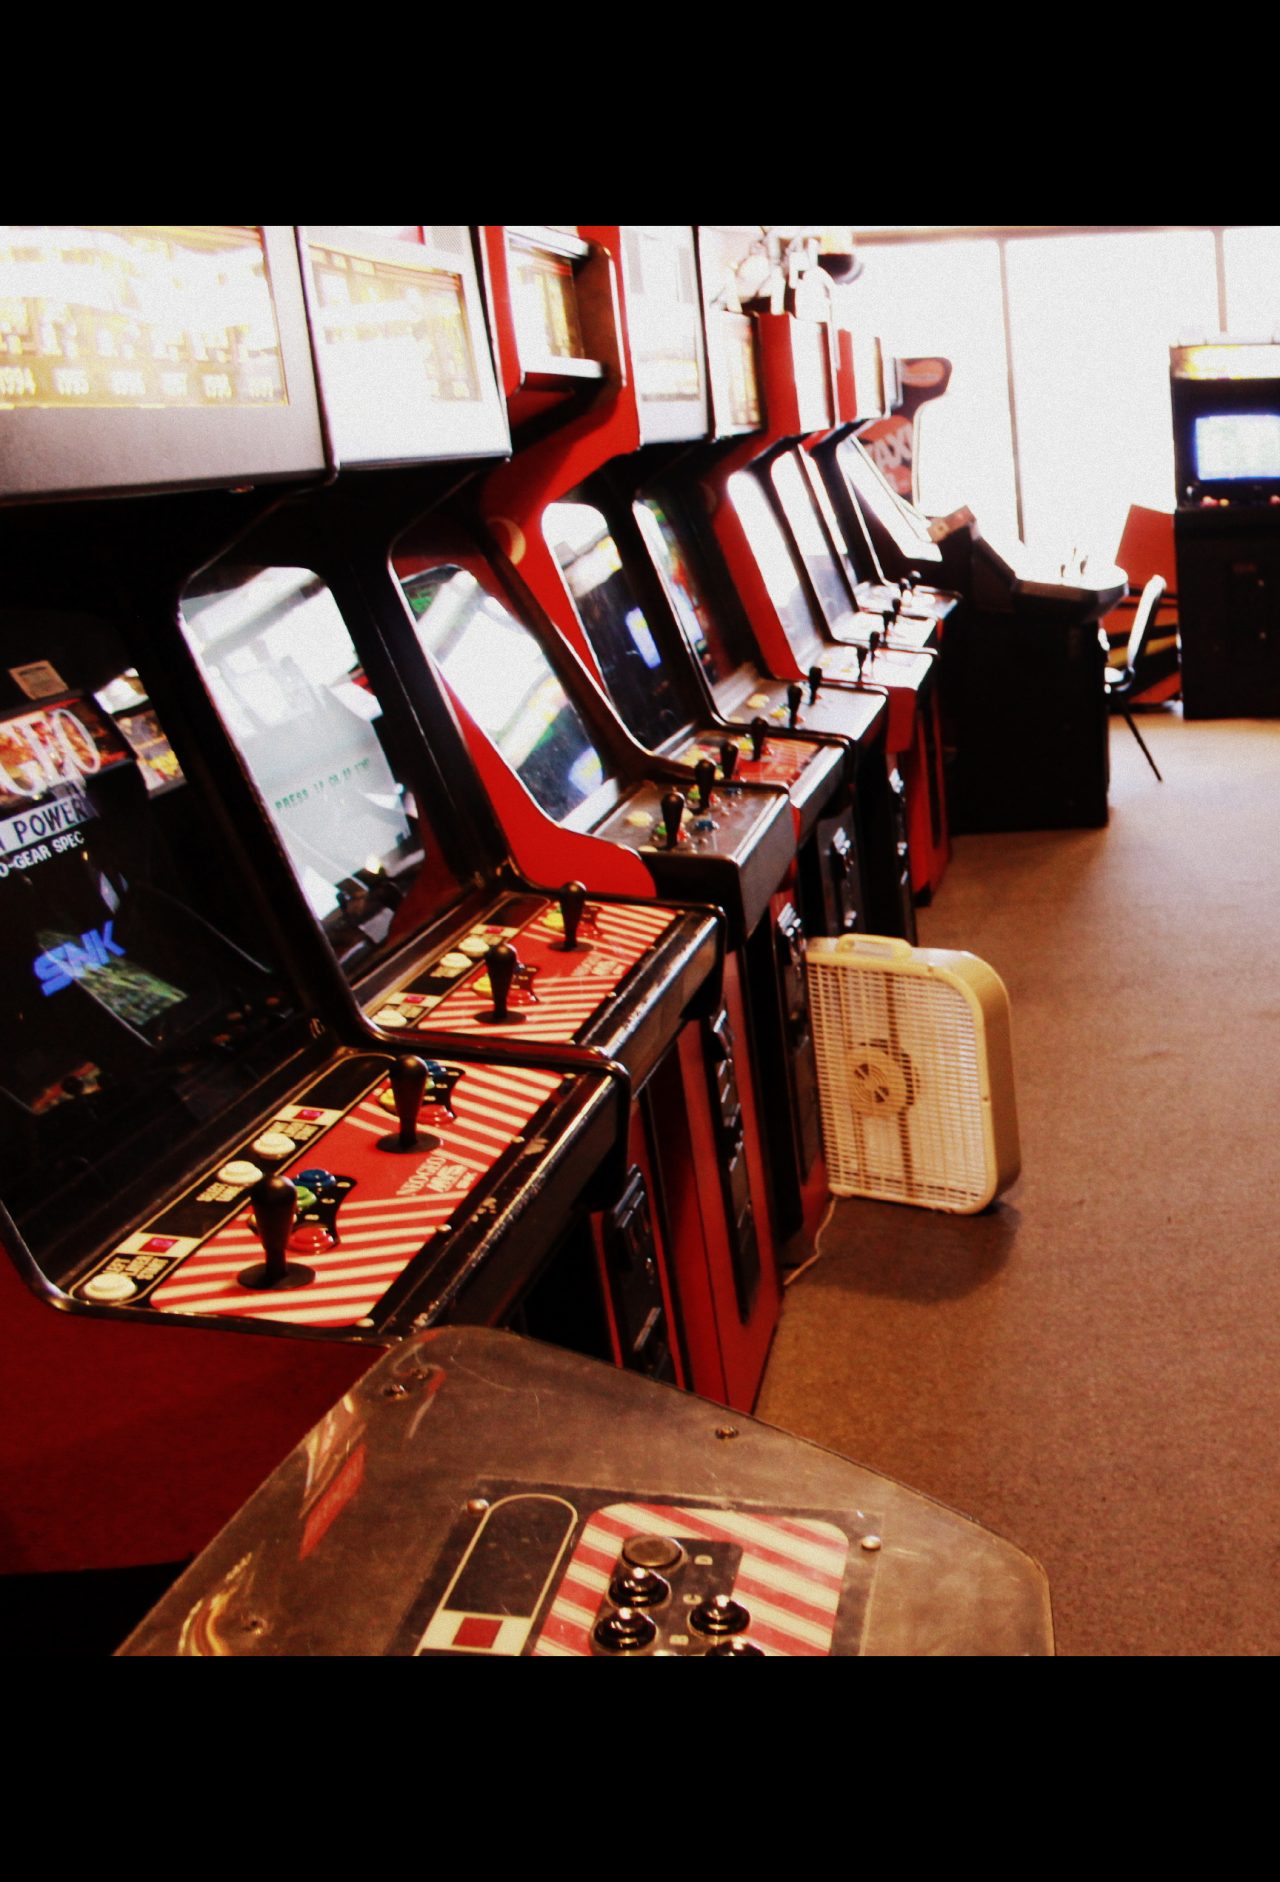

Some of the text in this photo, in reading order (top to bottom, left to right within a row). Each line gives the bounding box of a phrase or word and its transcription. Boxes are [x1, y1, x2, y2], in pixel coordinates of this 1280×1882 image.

[13, 796, 89, 846] POWER
[52, 830, 86, 855] SPEC
[33, 920, 126, 997] SNK
